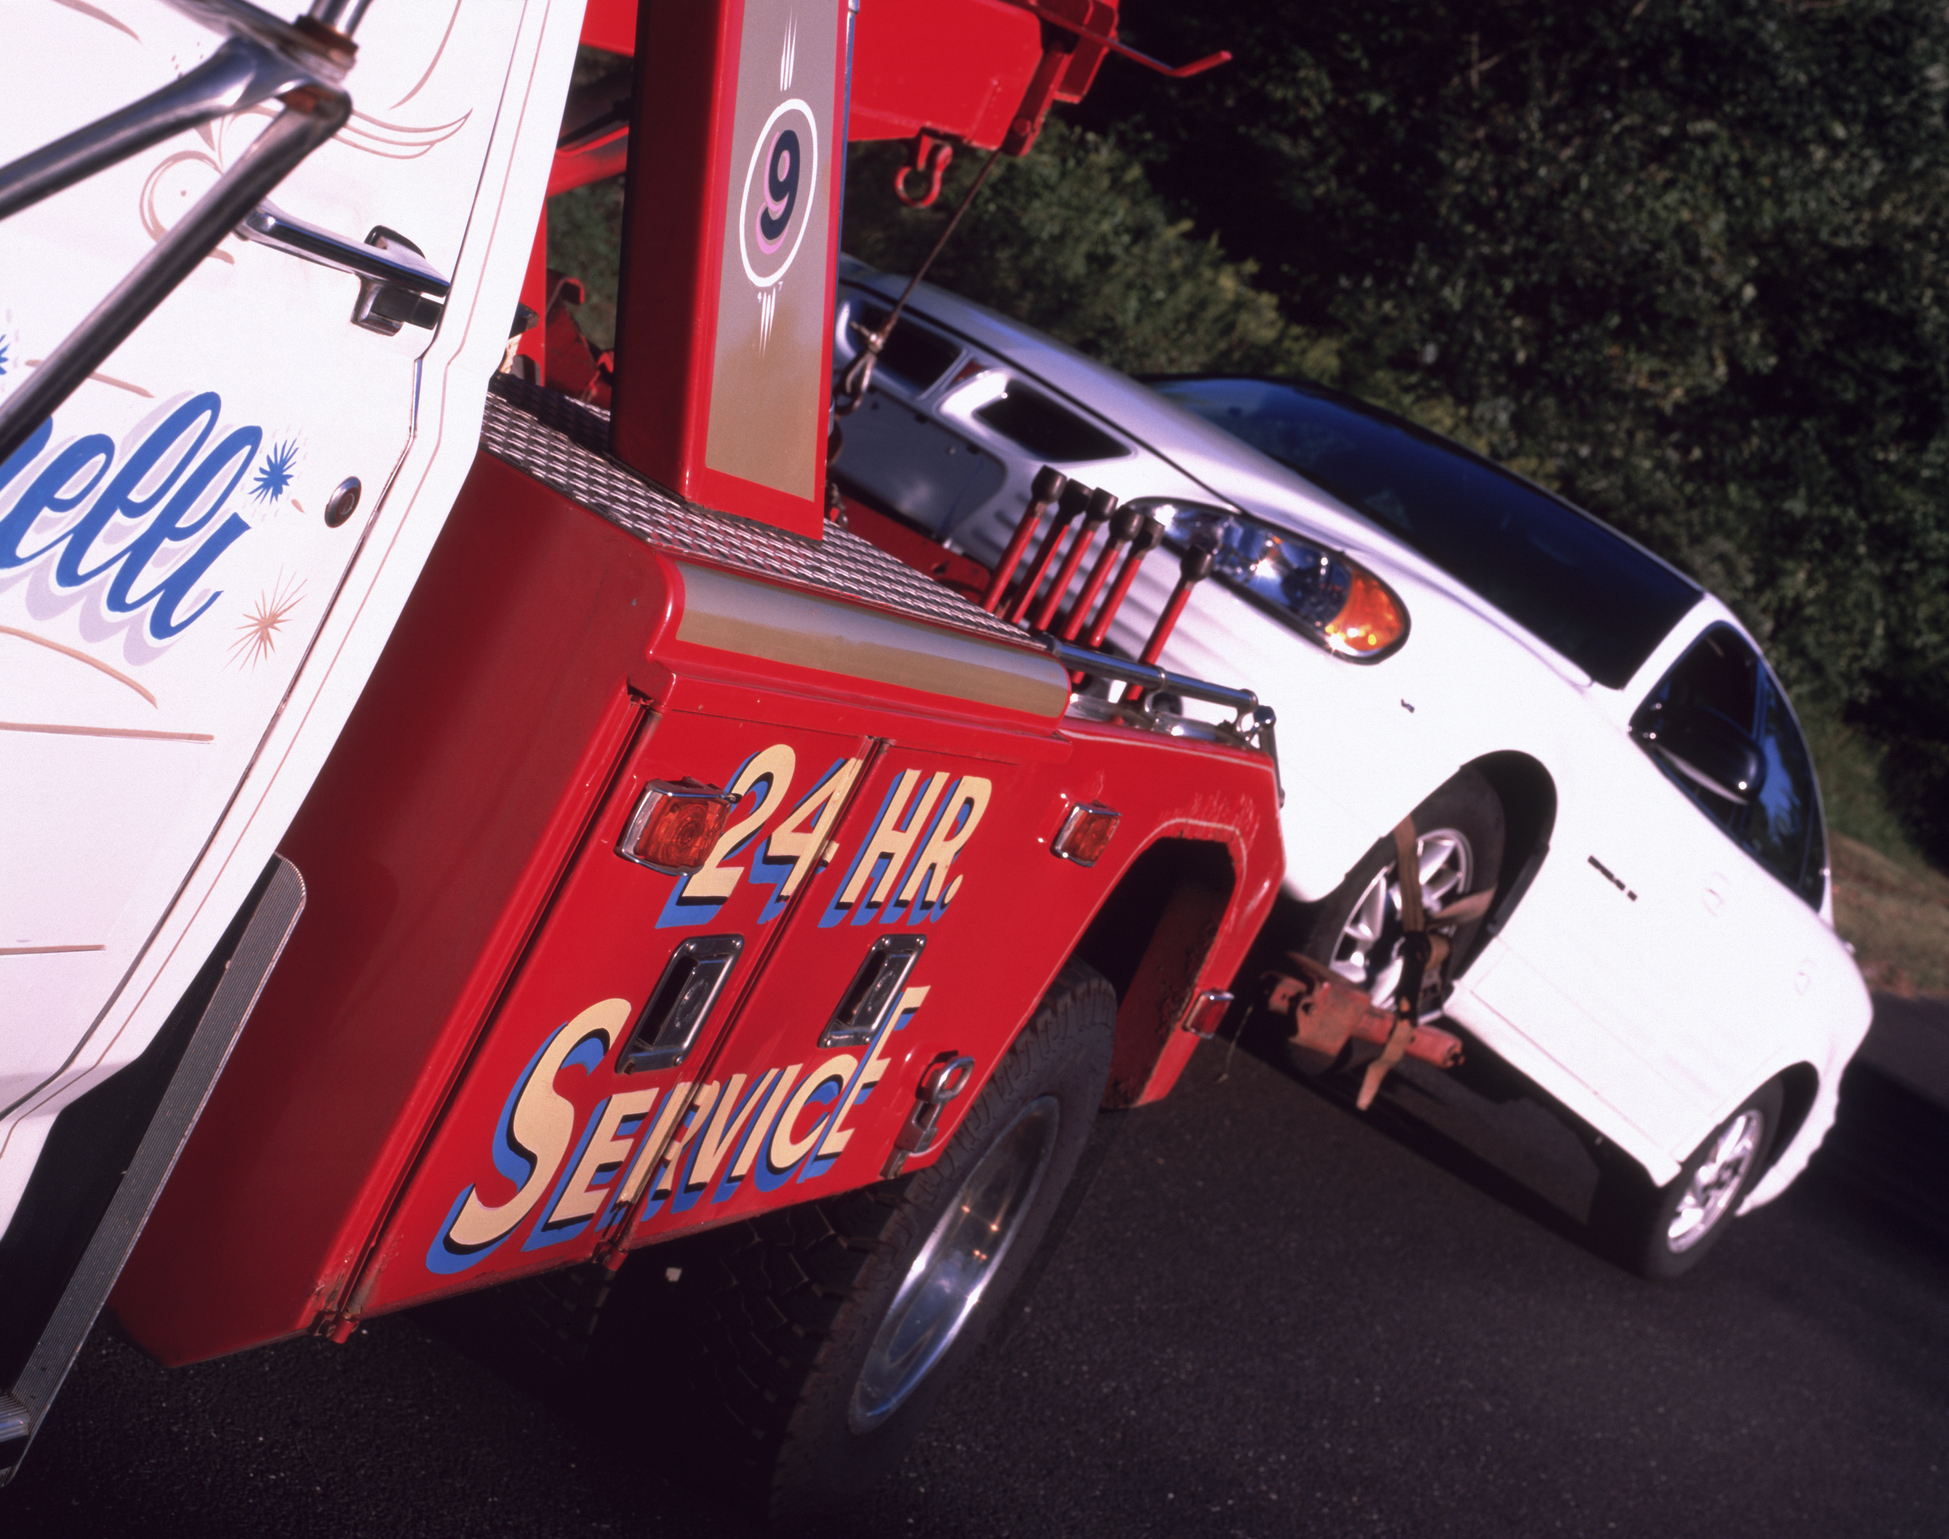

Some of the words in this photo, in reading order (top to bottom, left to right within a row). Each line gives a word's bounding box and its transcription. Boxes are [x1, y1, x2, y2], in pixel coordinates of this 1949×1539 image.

[757, 129, 800, 247] 9
[0, 391, 252, 641] elli
[672, 744, 863, 910] 24
[831, 768, 992, 914] HR.
[440, 985, 931, 1255] SERVICE
